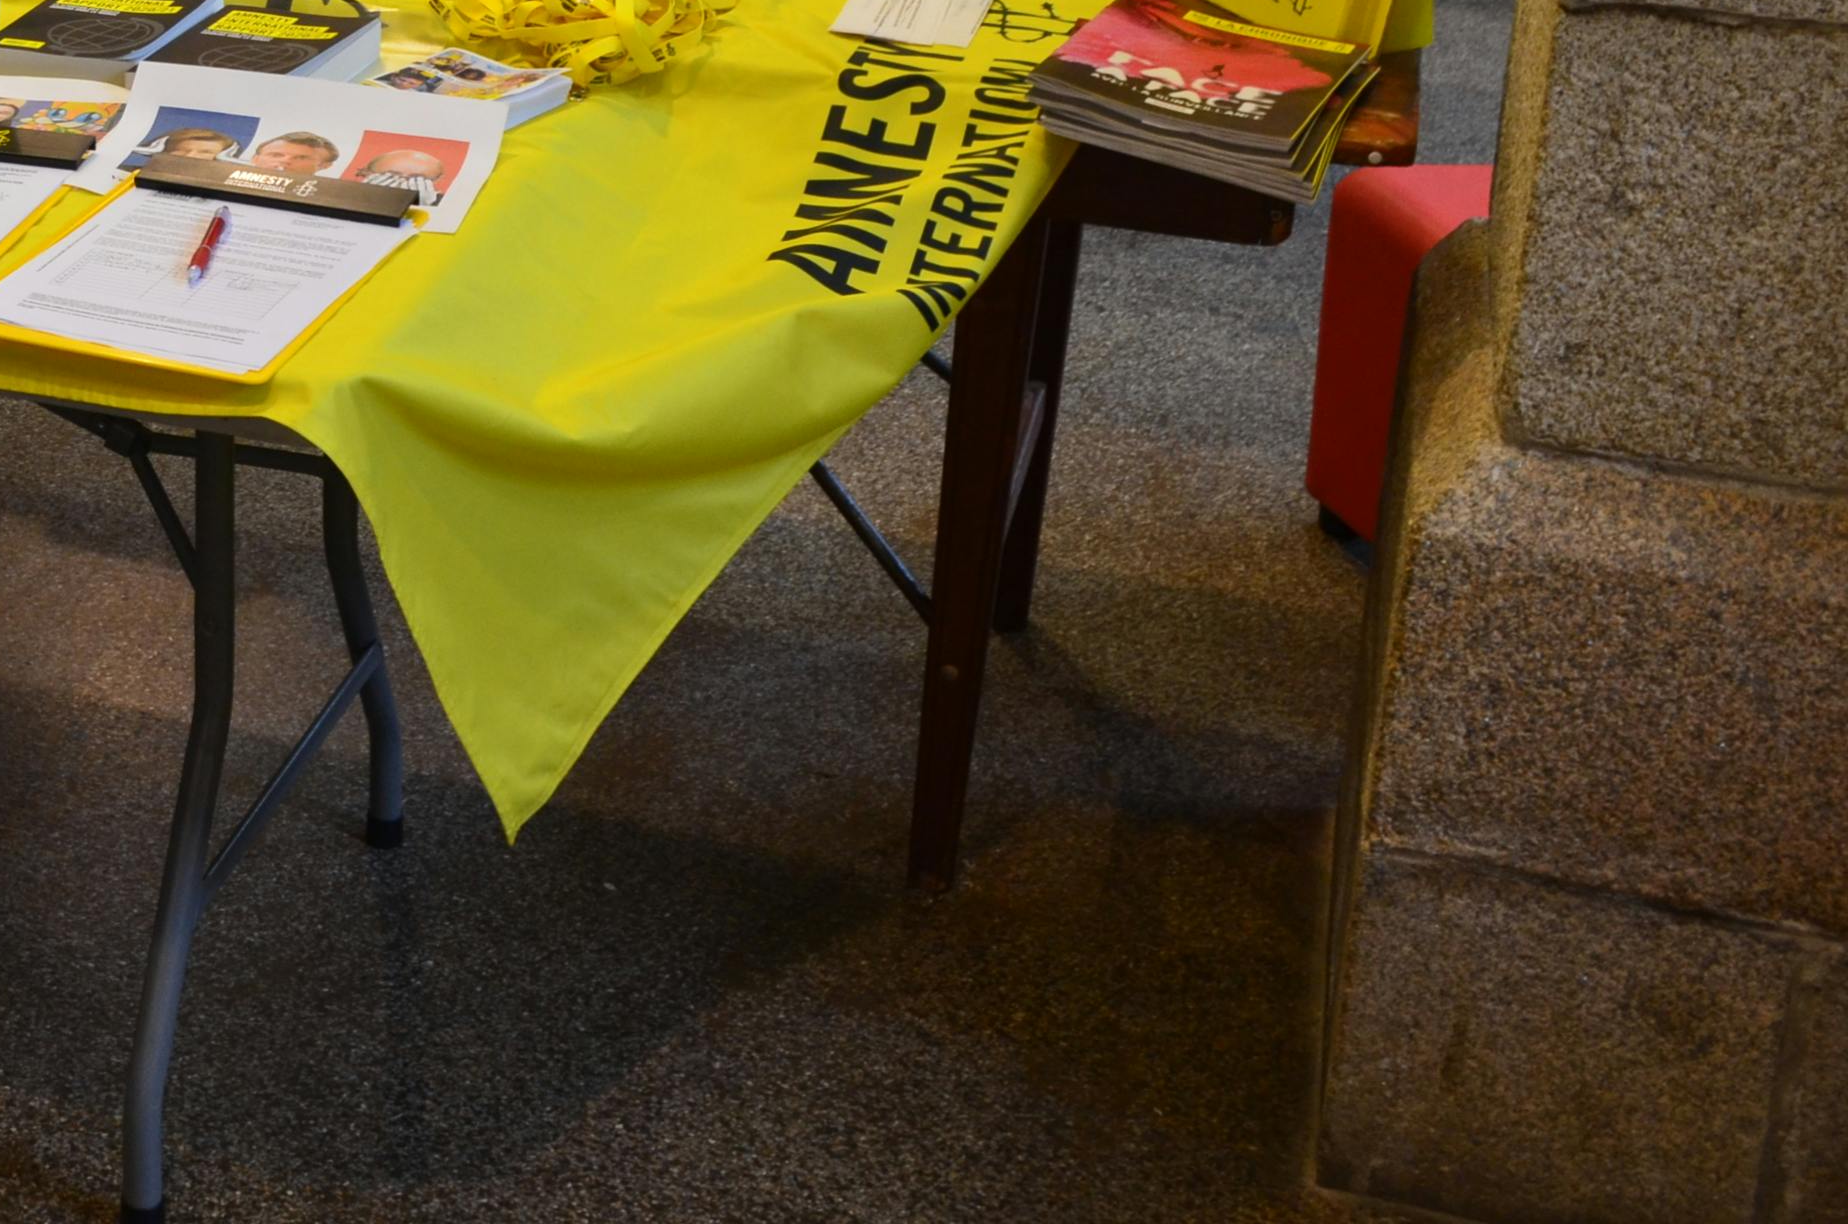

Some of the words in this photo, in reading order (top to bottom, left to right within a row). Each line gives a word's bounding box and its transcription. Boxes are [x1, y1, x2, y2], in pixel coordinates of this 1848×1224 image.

[225, 17, 321, 33] INTERNATIONAL
[232, 12, 290, 23] AMNESTY
[1107, 50, 1283, 104] FACE
[1145, 79, 1276, 116] FACE
[228, 168, 294, 187] AMNESTY
